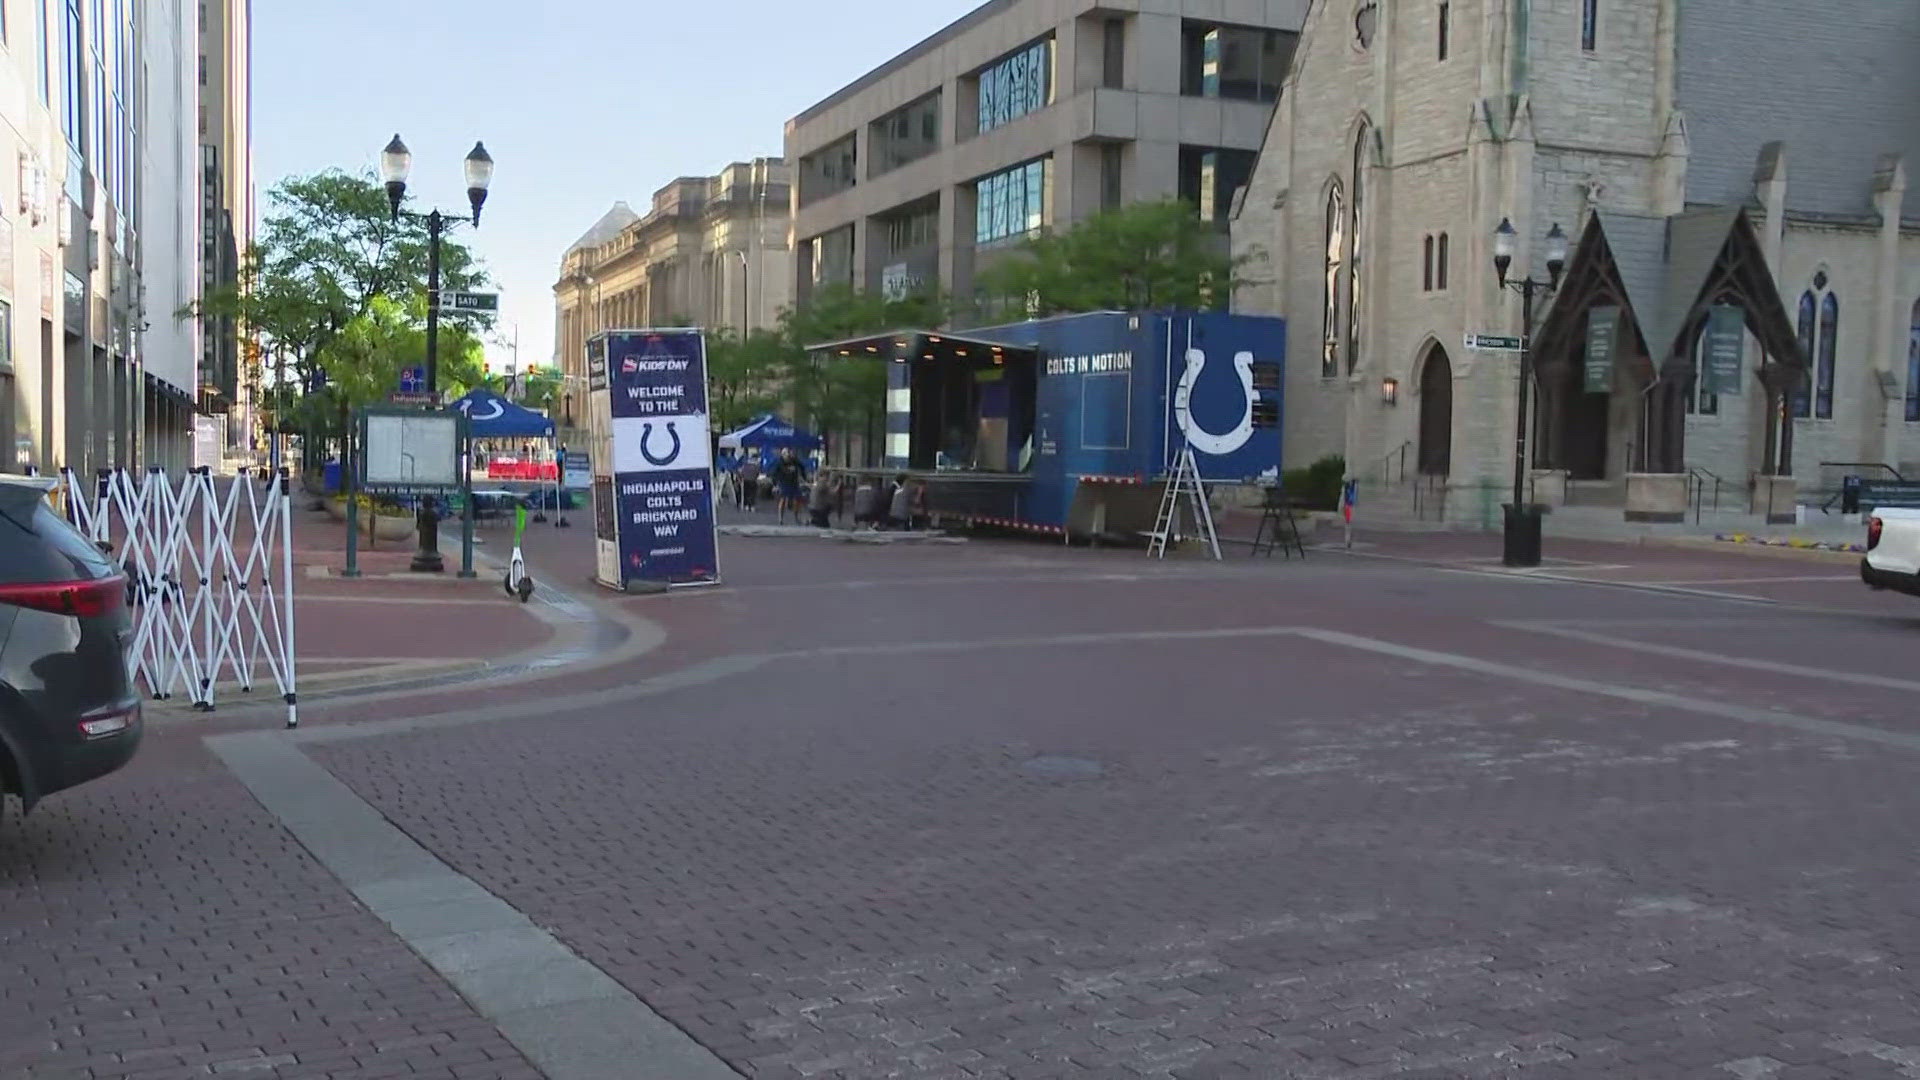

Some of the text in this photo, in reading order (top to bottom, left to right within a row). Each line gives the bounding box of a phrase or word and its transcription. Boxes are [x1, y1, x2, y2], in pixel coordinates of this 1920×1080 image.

[1046, 351, 1132, 375] COLTS IN MOTION
[628, 386, 684, 398] WELCOME
[639, 400, 679, 412] TO THE
[623, 480, 703, 494] INDIANAPOLIS
[646, 496, 682, 508] COLTS
[633, 509, 697, 523] BRICKYARD
[653, 525, 678, 537] WAY
